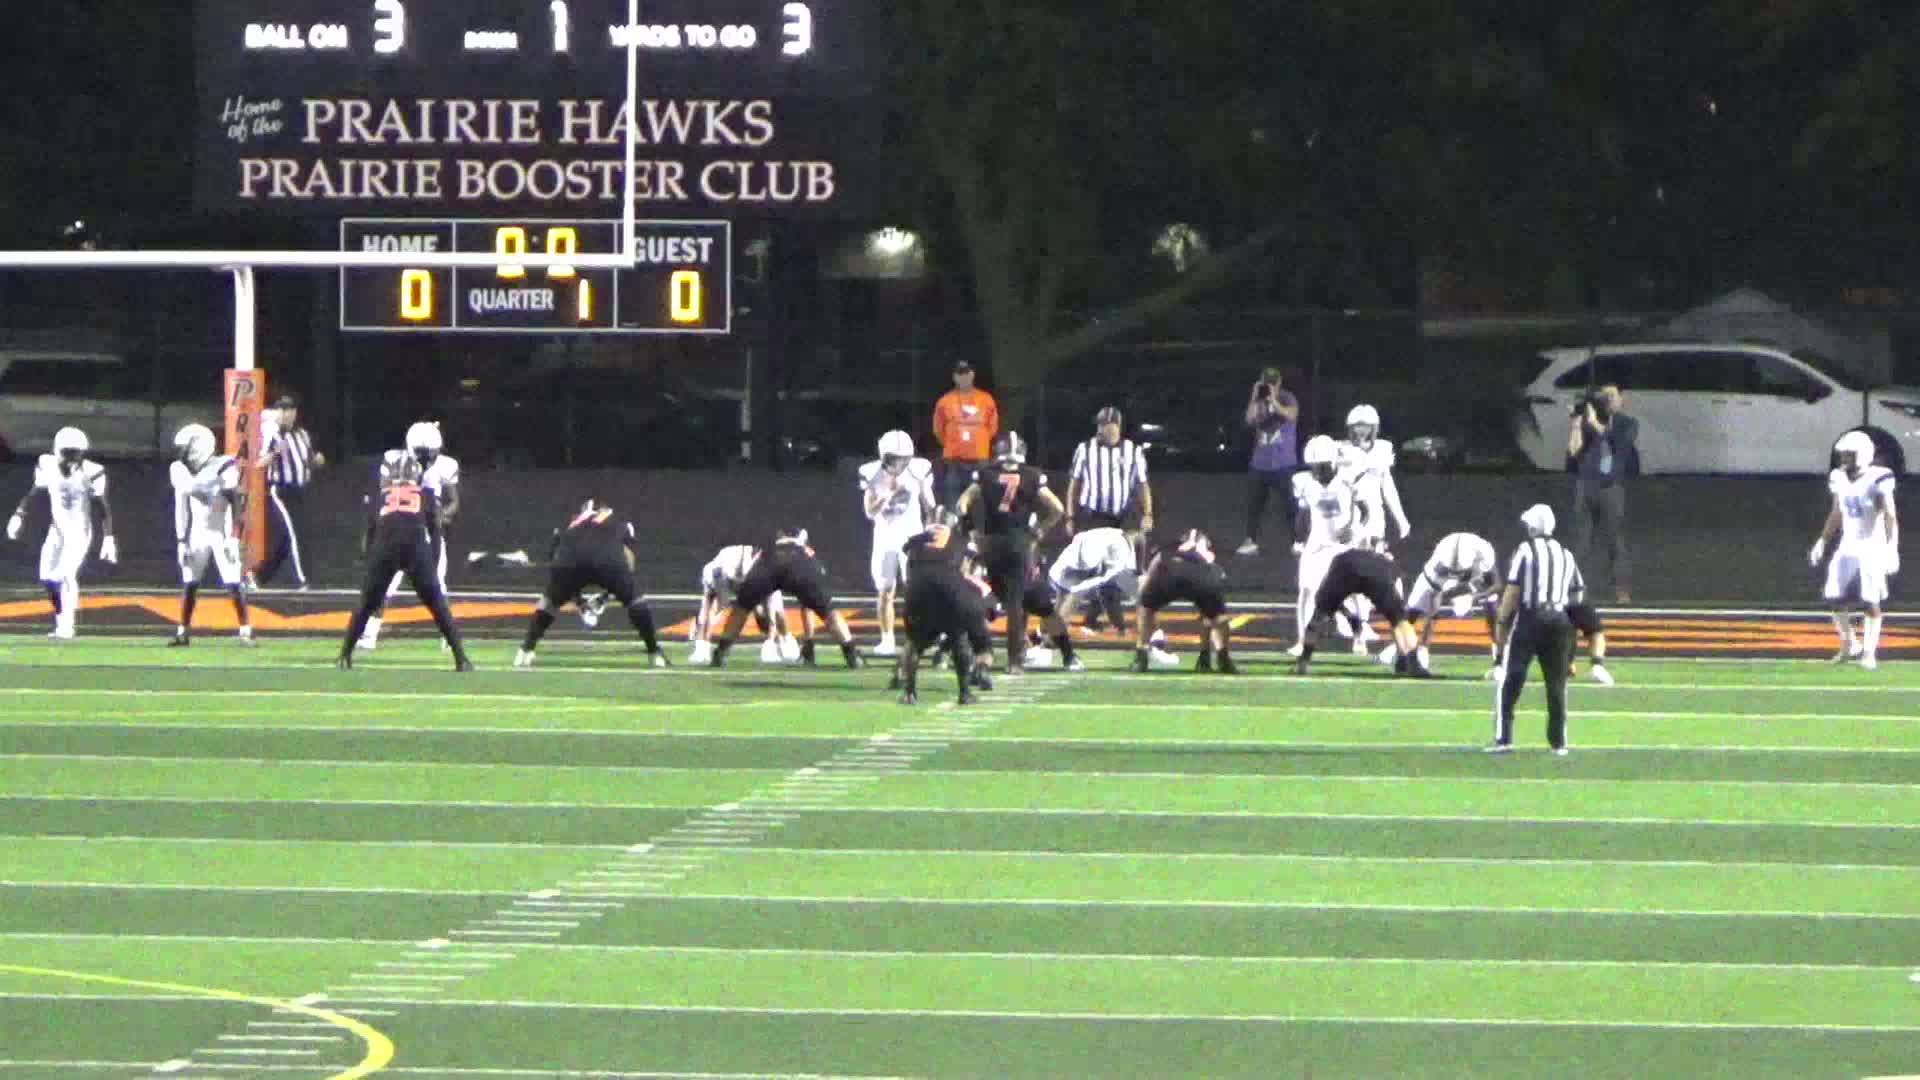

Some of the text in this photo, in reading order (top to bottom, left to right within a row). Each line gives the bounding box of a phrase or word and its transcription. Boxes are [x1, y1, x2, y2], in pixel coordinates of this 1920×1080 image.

[244, 24, 347, 48] BALL ON
[374, 0, 403, 53] 3
[551, 0, 568, 51] 1
[684, 24, 716, 47] TO
[720, 24, 756, 47] GO
[782, 2, 811, 54] 3
[220, 95, 284, 122] Home
[302, 98, 774, 146] PRAIRIE HAWKS
[230, 115, 284, 142] of the
[239, 157, 835, 200] PRAIRIE BOOSTER CLUB
[362, 234, 439, 253] HOME
[634, 236, 713, 263] GUEST
[401, 269, 431, 319] 0
[469, 288, 555, 314] QUARTER
[578, 278, 589, 320] 1
[671, 270, 700, 321] 0
[380, 485, 421, 516] 35
[997, 473, 1021, 512] 7
